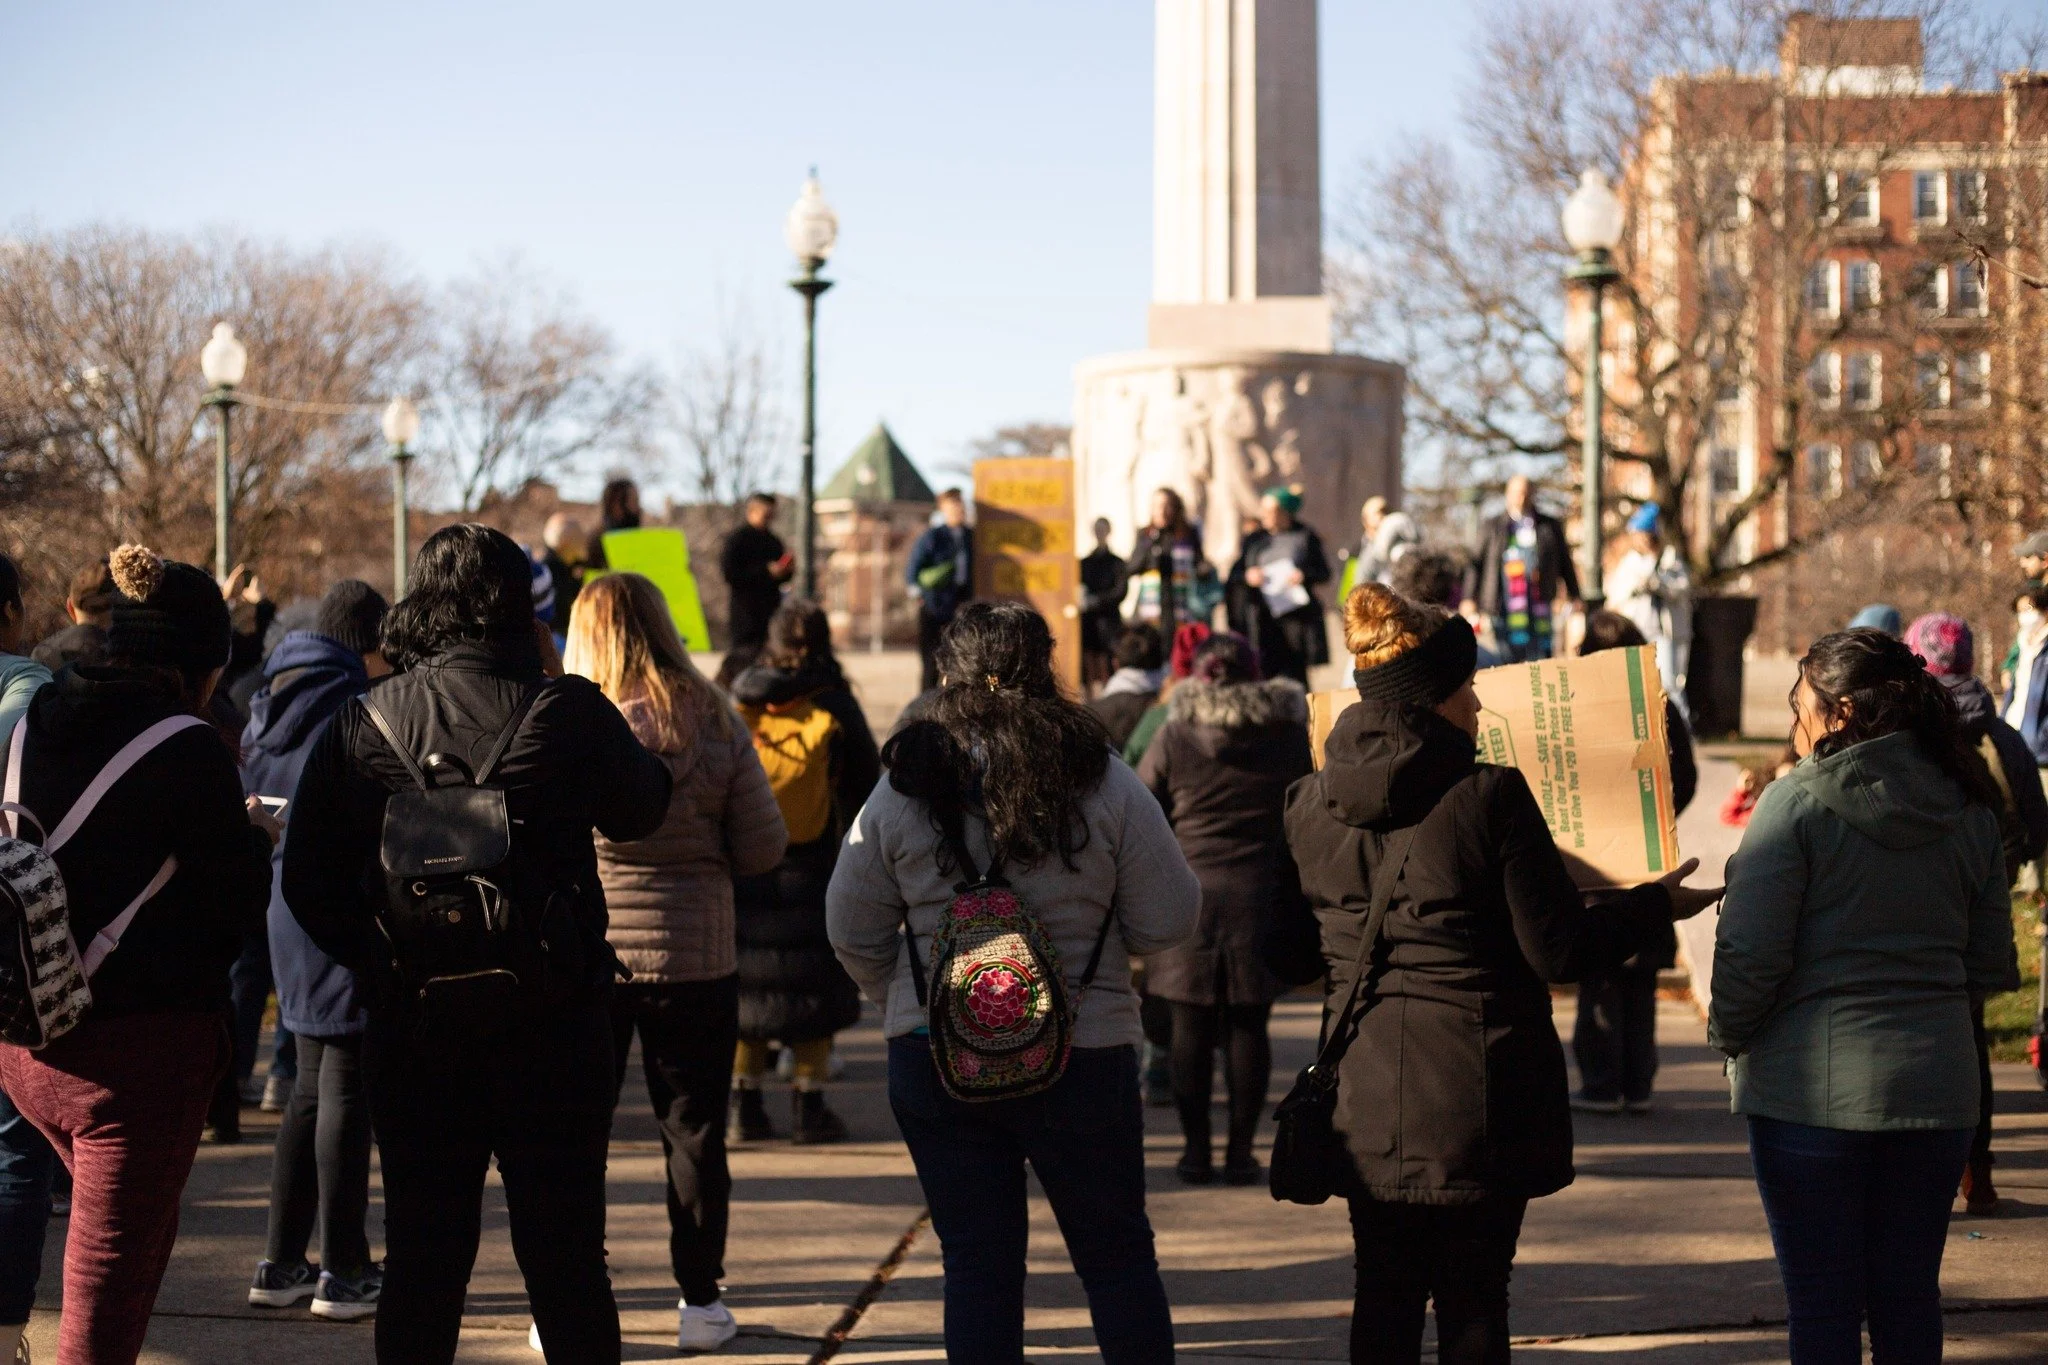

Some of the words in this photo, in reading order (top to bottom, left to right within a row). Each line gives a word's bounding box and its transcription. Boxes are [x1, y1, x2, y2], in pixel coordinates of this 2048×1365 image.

[1530, 665, 1542, 697] MORE
[1545, 682, 1557, 704] and
[1533, 701, 1545, 730] EVEN
[1548, 707, 1560, 741] Prices
[1560, 705, 1573, 733] FREE
[1552, 744, 1565, 781] Bundle
[1568, 771, 1580, 792] You
[1570, 794, 1582, 818] Give
[1558, 808, 1571, 833] Beat
